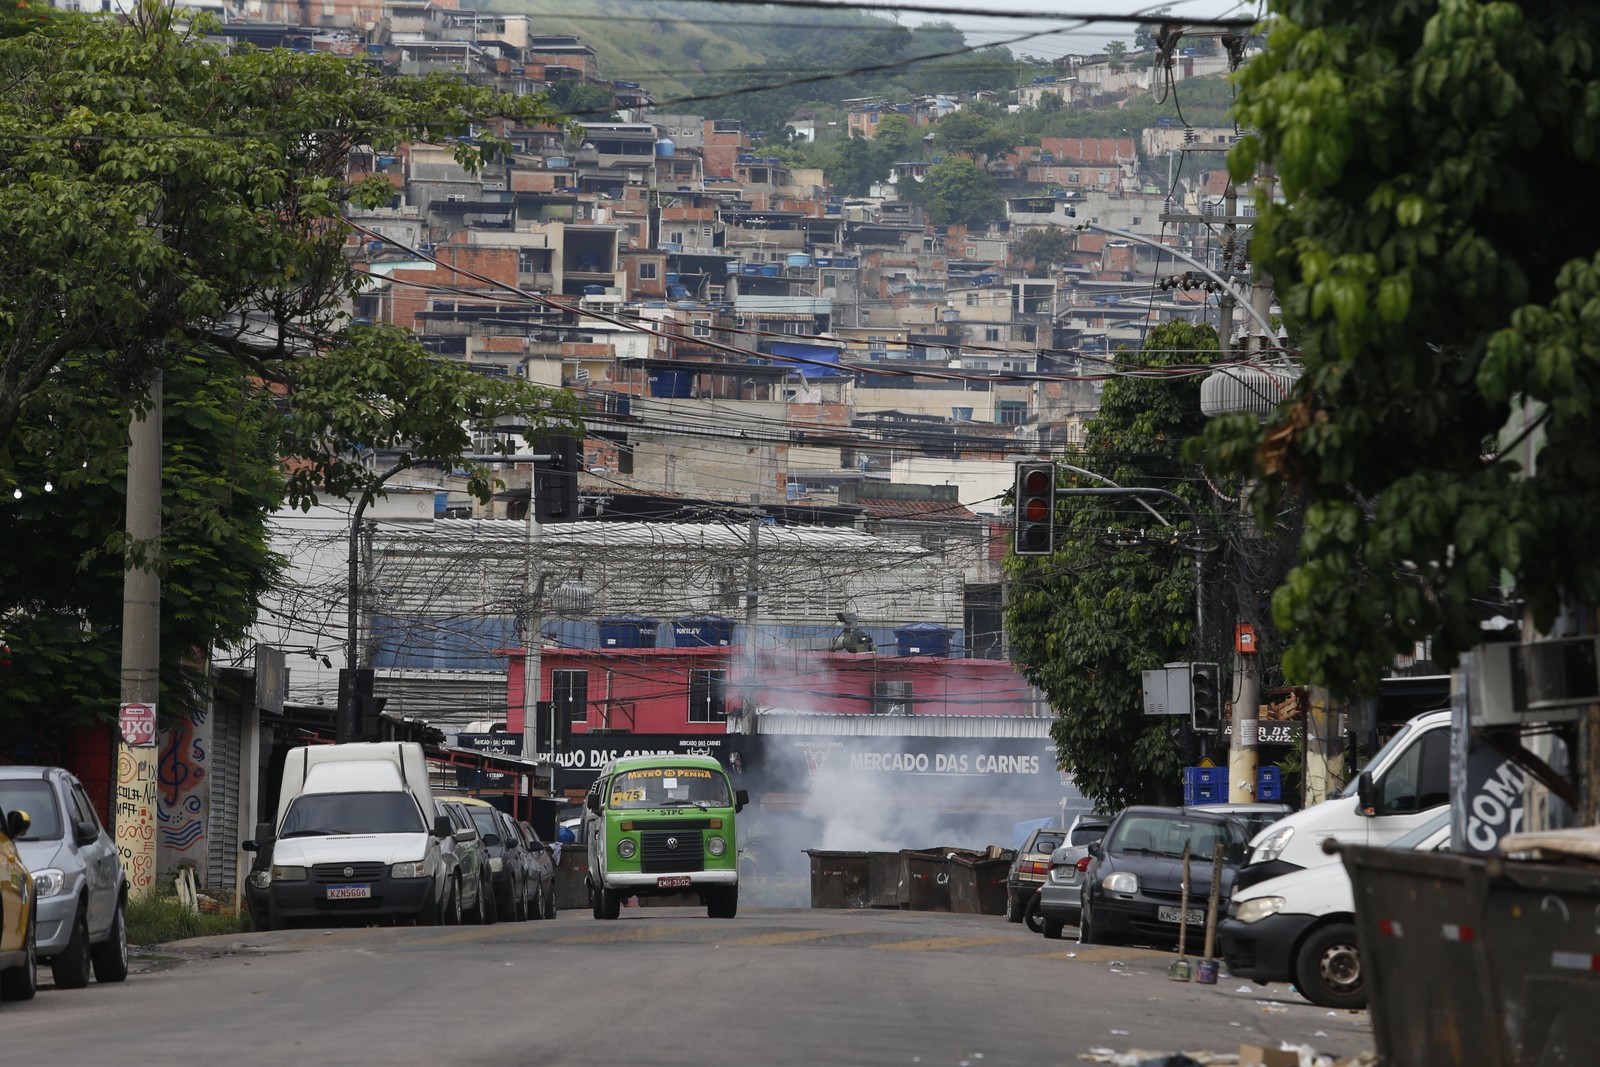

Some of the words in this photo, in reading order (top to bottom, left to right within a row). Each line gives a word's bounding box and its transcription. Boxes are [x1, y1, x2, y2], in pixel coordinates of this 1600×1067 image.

[119, 721, 154, 734] LIXO
[590, 749, 618, 768] DAS
[849, 752, 930, 772] MERCADO
[935, 753, 969, 773] DAS
[975, 754, 1040, 775] CARNES
[627, 769, 663, 779] METRO
[677, 769, 712, 779] PENHA
[626, 791, 640, 800] 75
